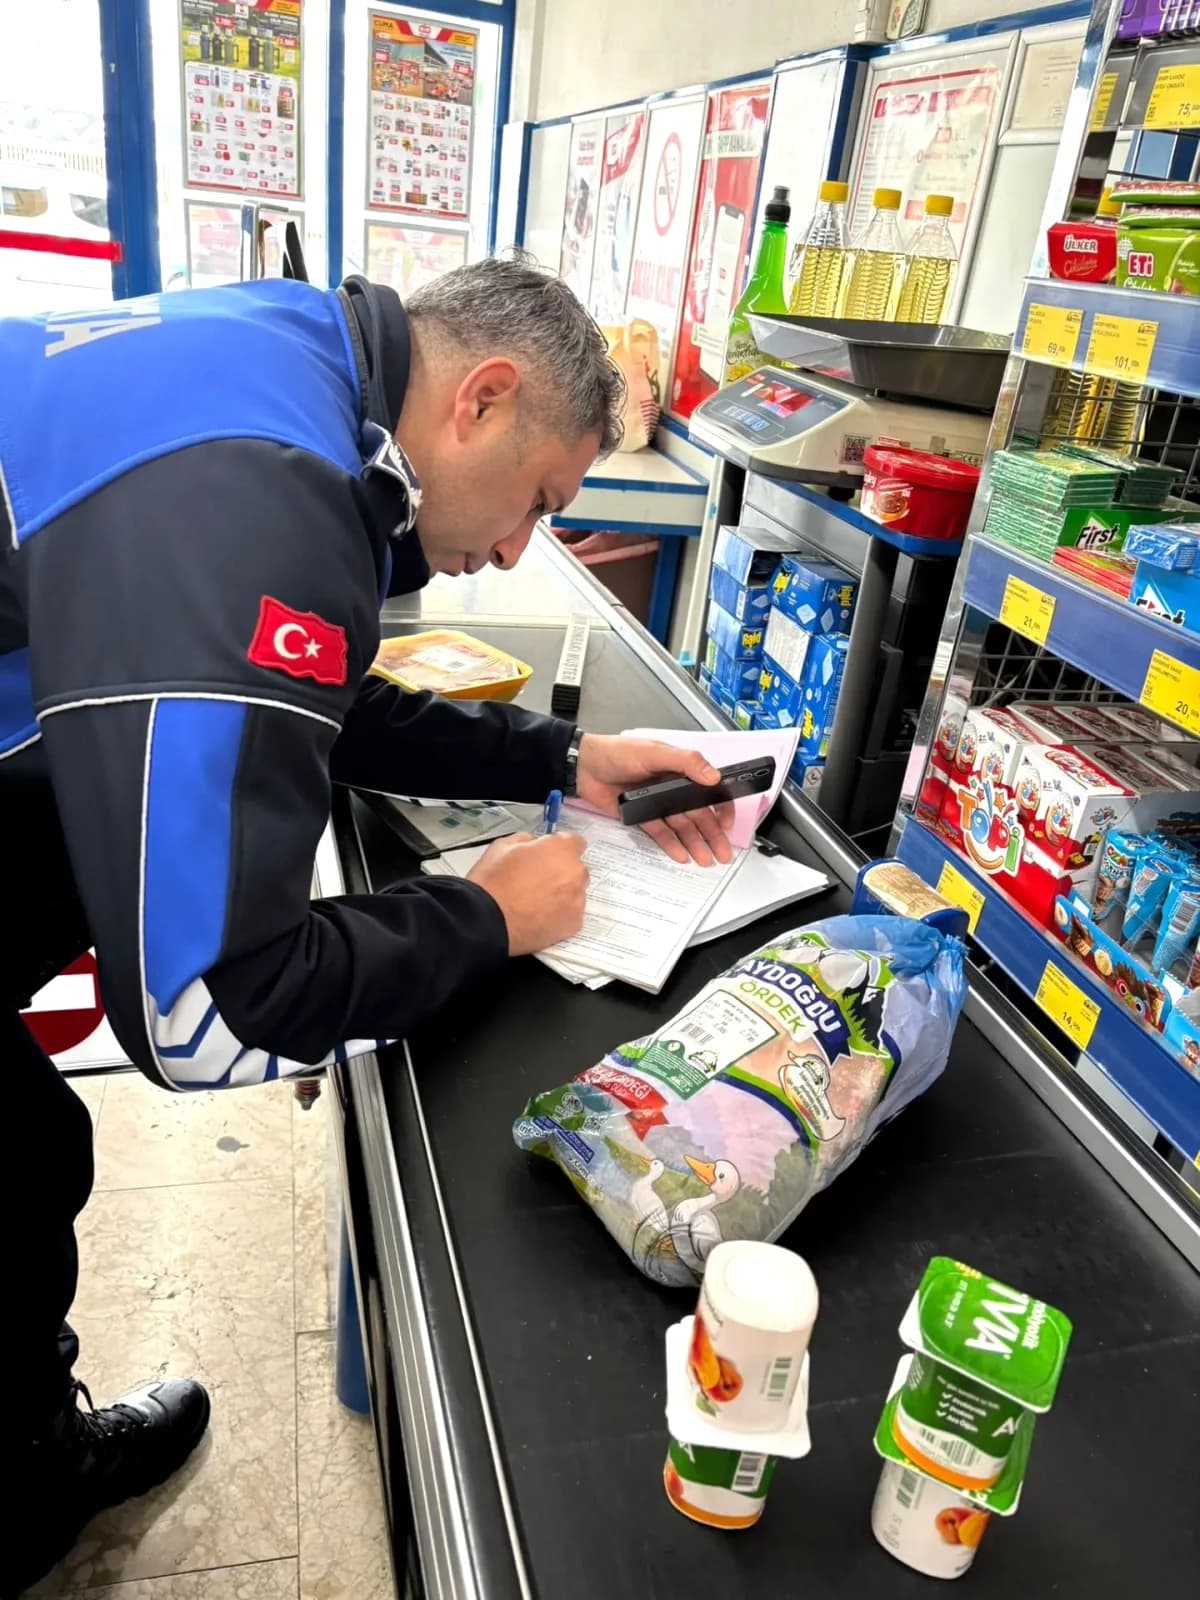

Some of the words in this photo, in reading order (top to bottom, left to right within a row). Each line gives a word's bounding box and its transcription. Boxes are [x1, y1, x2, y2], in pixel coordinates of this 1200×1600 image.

[1064, 235, 1098, 253] ÜLKER
[1075, 523, 1121, 548] First
[738, 979, 806, 1035] ÖRDEK
